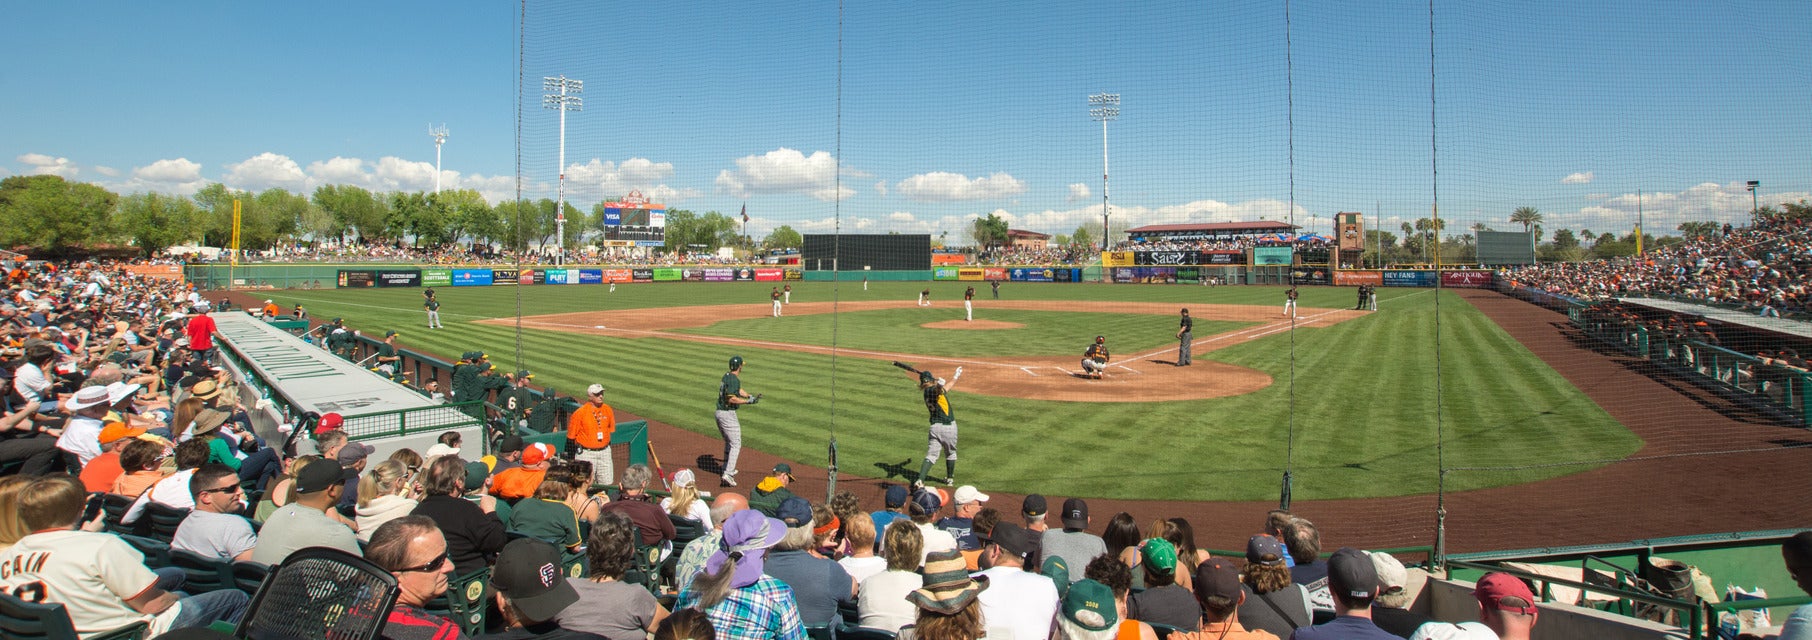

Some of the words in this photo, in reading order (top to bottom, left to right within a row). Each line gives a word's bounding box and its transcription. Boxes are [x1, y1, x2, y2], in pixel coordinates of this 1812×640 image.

[1111, 252, 1125, 260] ASU
[508, 396, 517, 409] 6
[1, 551, 52, 580] CAIN
